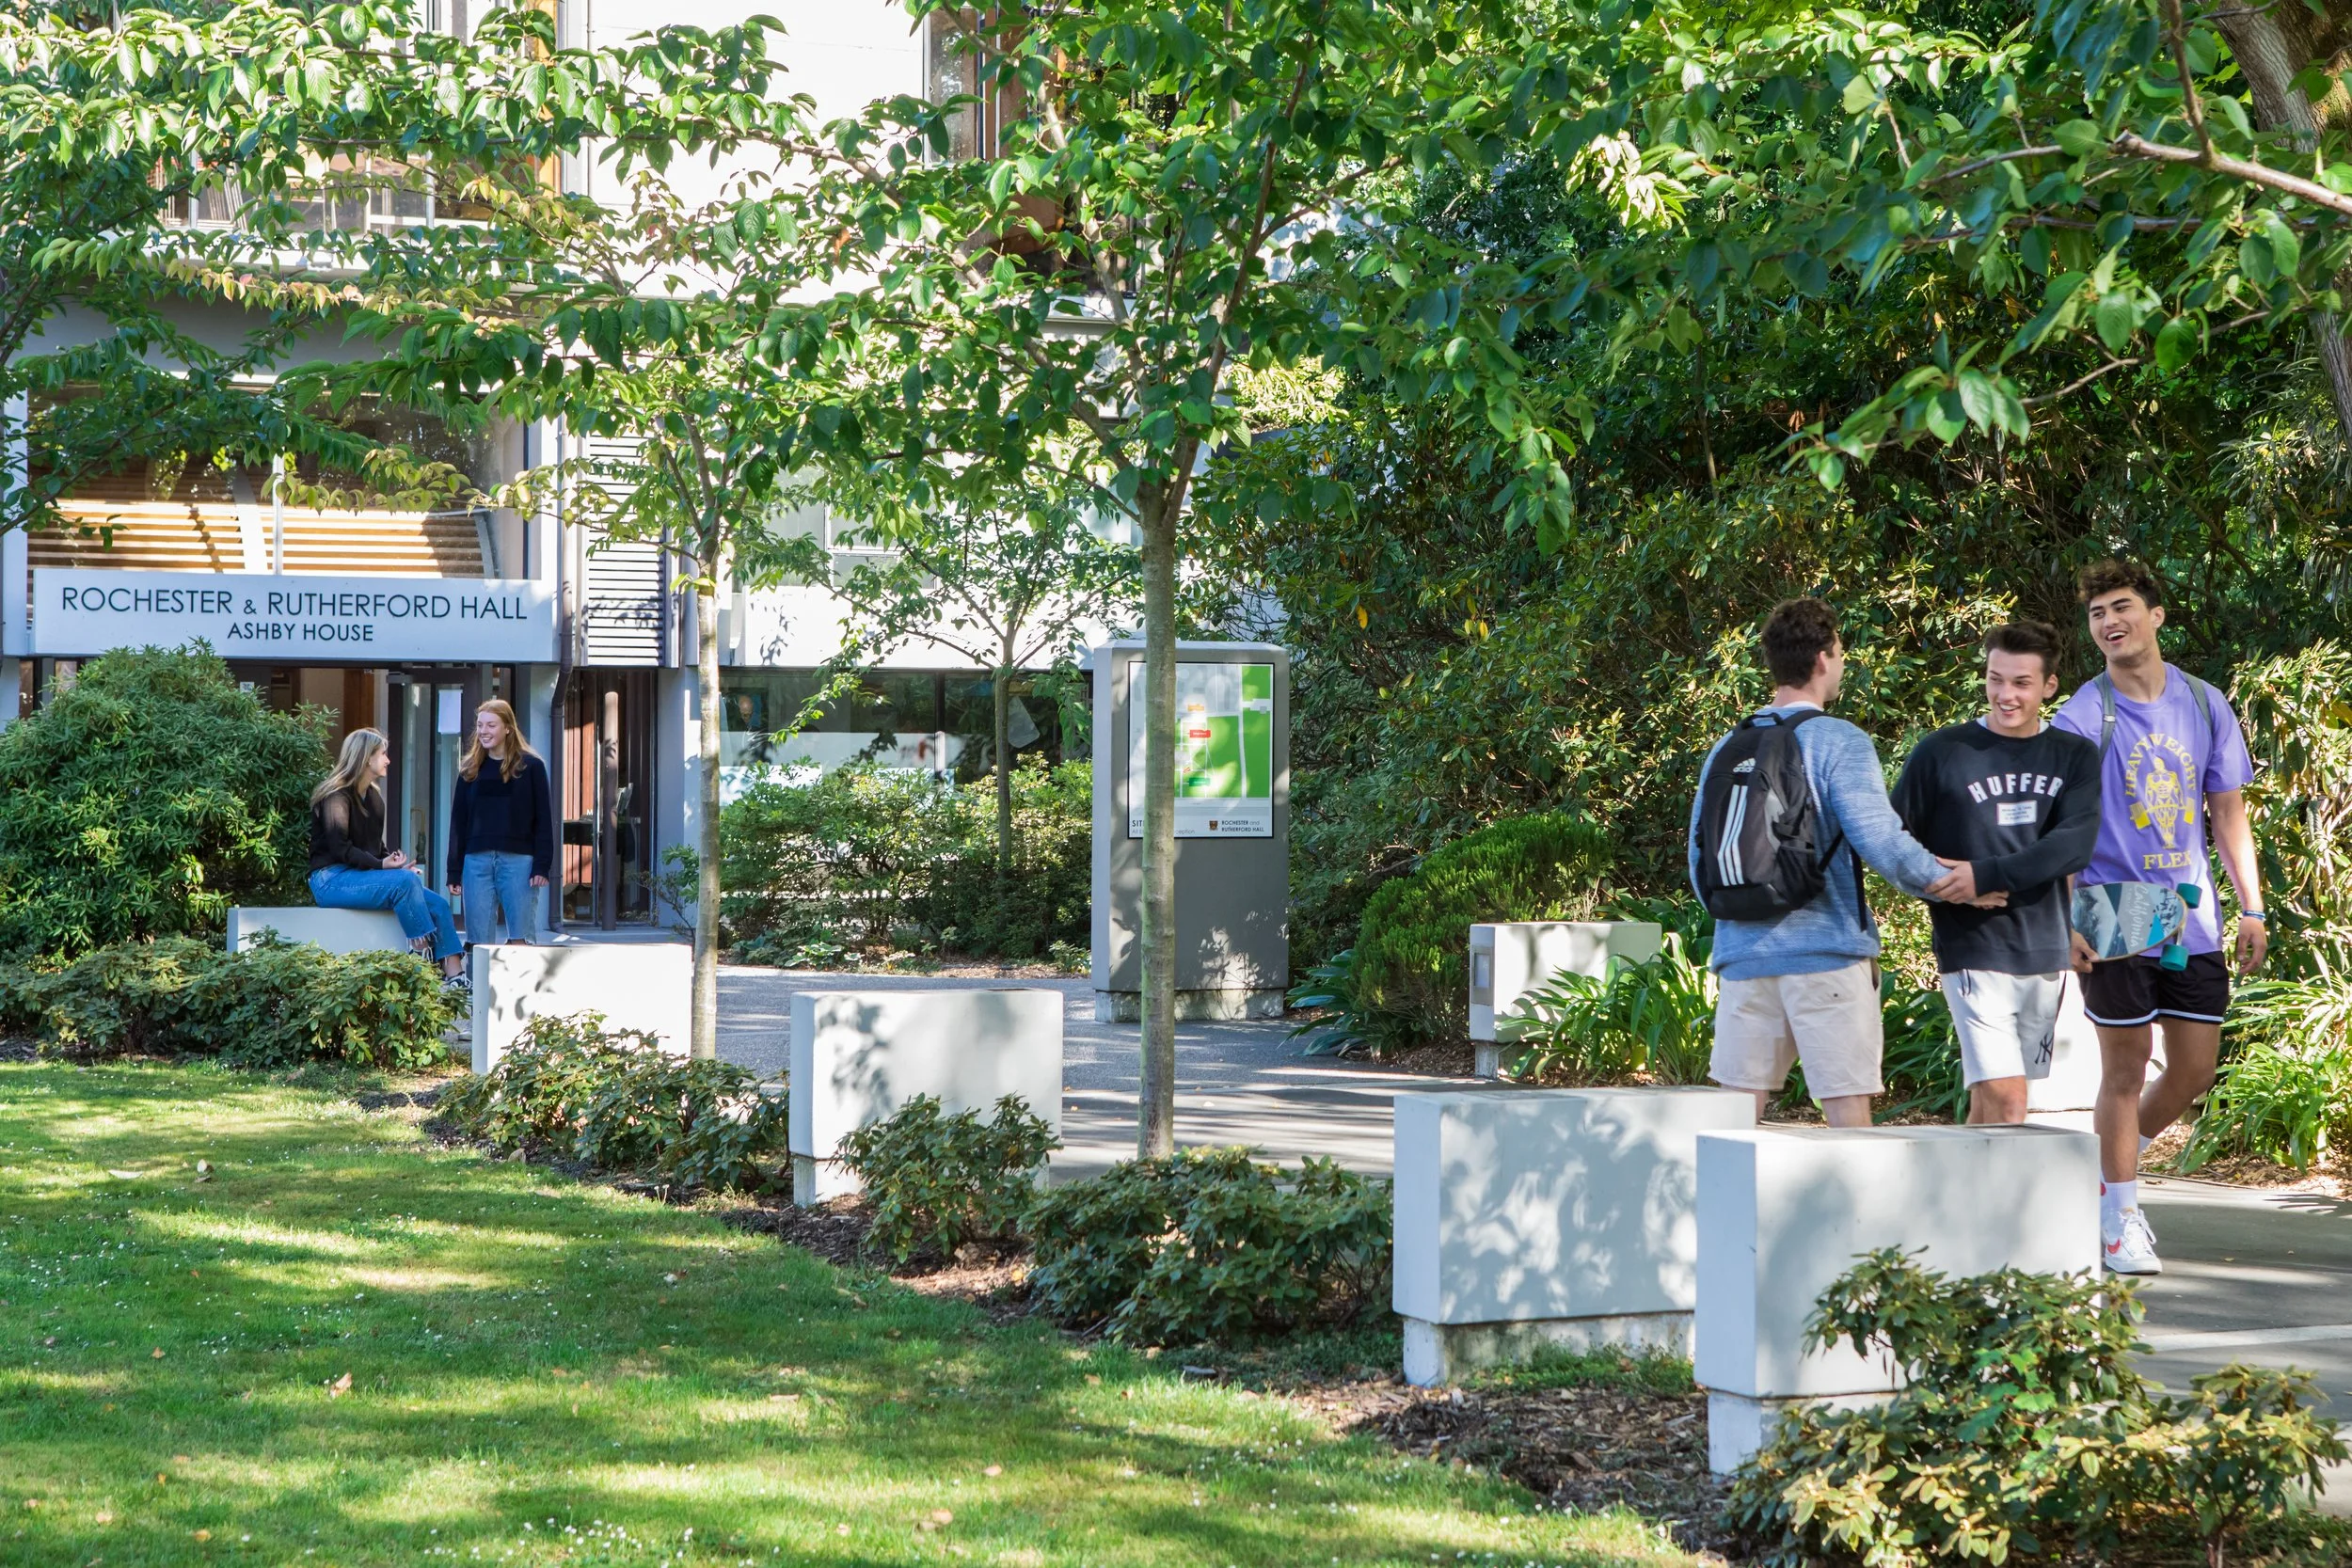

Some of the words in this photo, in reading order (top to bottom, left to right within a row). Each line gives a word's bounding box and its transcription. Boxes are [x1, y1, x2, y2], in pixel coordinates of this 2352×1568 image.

[62, 587, 233, 614] ROCHESTER
[243, 599, 257, 614] &
[268, 592, 451, 618] RUTHERFORD
[461, 595, 528, 620] HALL
[227, 622, 296, 640] ASHBY
[303, 624, 373, 641] HOUSE
[2125, 734, 2196, 797] HEAVYWEIGHT
[1967, 772, 2064, 803] HUFFER
[1132, 819, 1144, 828] SIT
[2129, 884, 2150, 947] California
